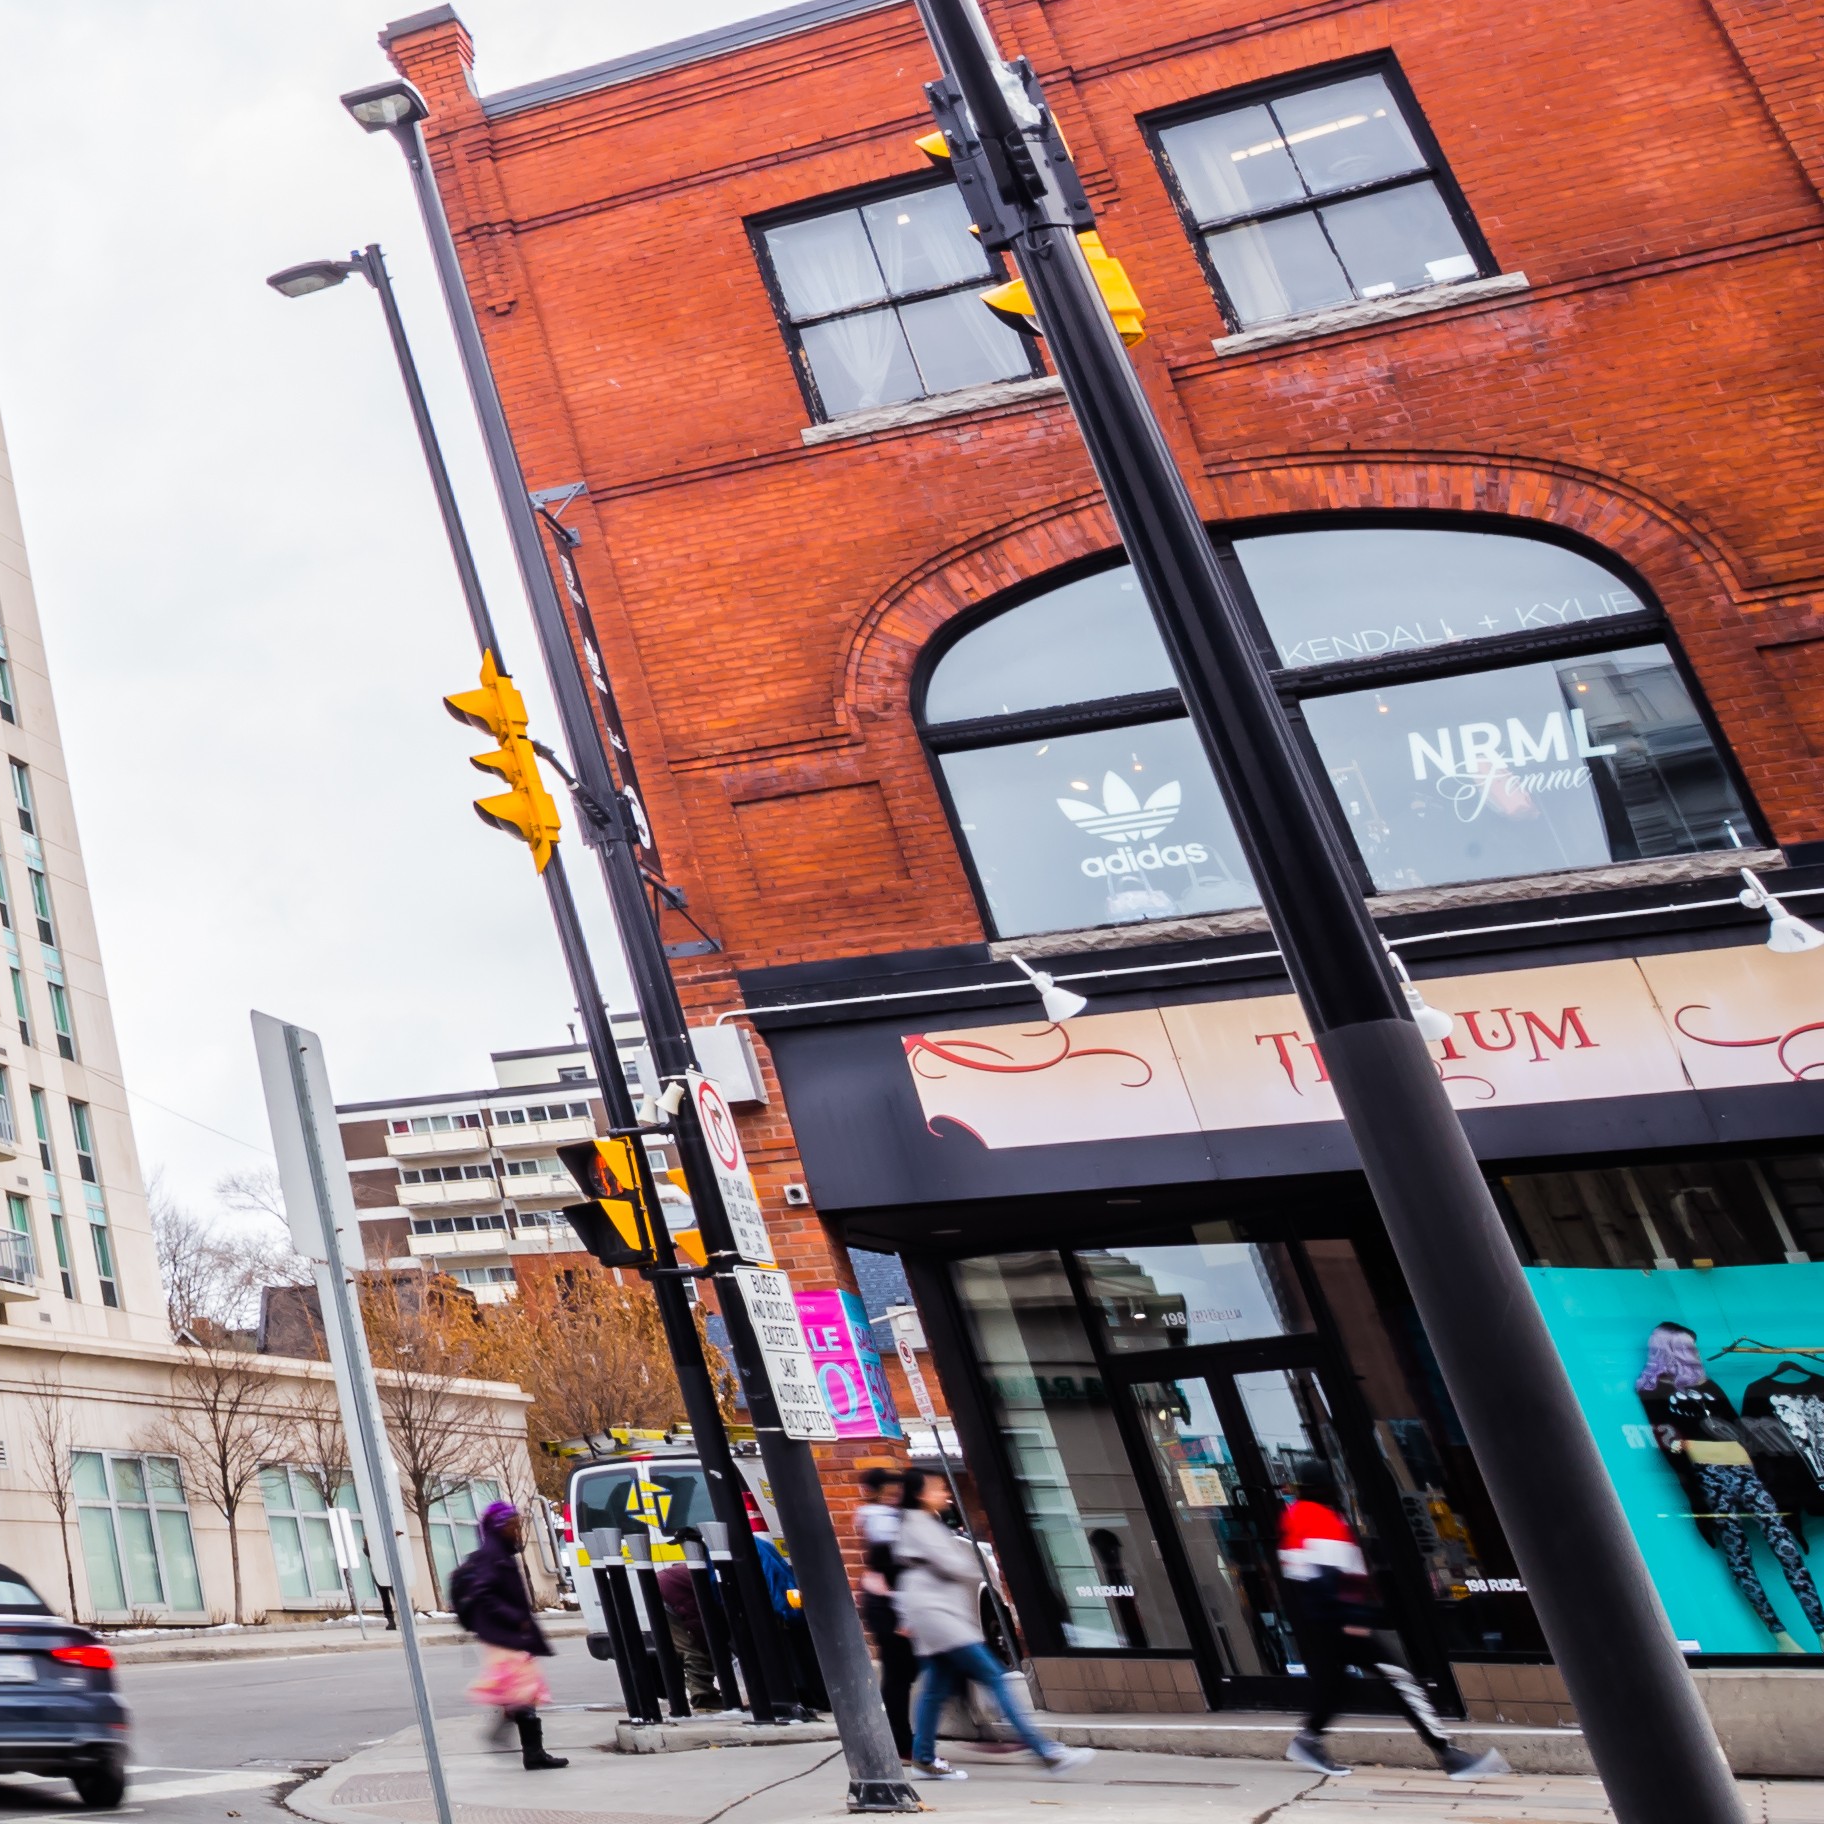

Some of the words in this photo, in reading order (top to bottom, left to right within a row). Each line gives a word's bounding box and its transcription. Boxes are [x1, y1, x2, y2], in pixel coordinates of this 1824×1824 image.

[1281, 618, 1467, 666] KENDALL
[1478, 614, 1500, 630] +
[1514, 590, 1636, 628] KYLIE
[1408, 708, 1617, 781] NRML
[1436, 753, 1593, 823] Femme
[1080, 842, 1209, 878] adidas
[750, 1273, 781, 1296] BUSES
[752, 1299, 766, 1321] AND
[765, 1301, 796, 1322] BICYCLES
[1161, 1312, 1187, 1327] 198
[762, 1324, 799, 1346] EXCEPTED
[809, 1327, 842, 1352] LE
[779, 1357, 798, 1378] SAUF
[777, 1382, 809, 1404] AUTOBUS
[807, 1384, 821, 1405] ET
[783, 1408, 832, 1431] BICYCLETTES
[1075, 1586, 1092, 1596] 198
[1092, 1585, 1134, 1597] RIDEAU
[1465, 1579, 1487, 1592] 198
[1488, 1578, 1527, 1592] RIDE
